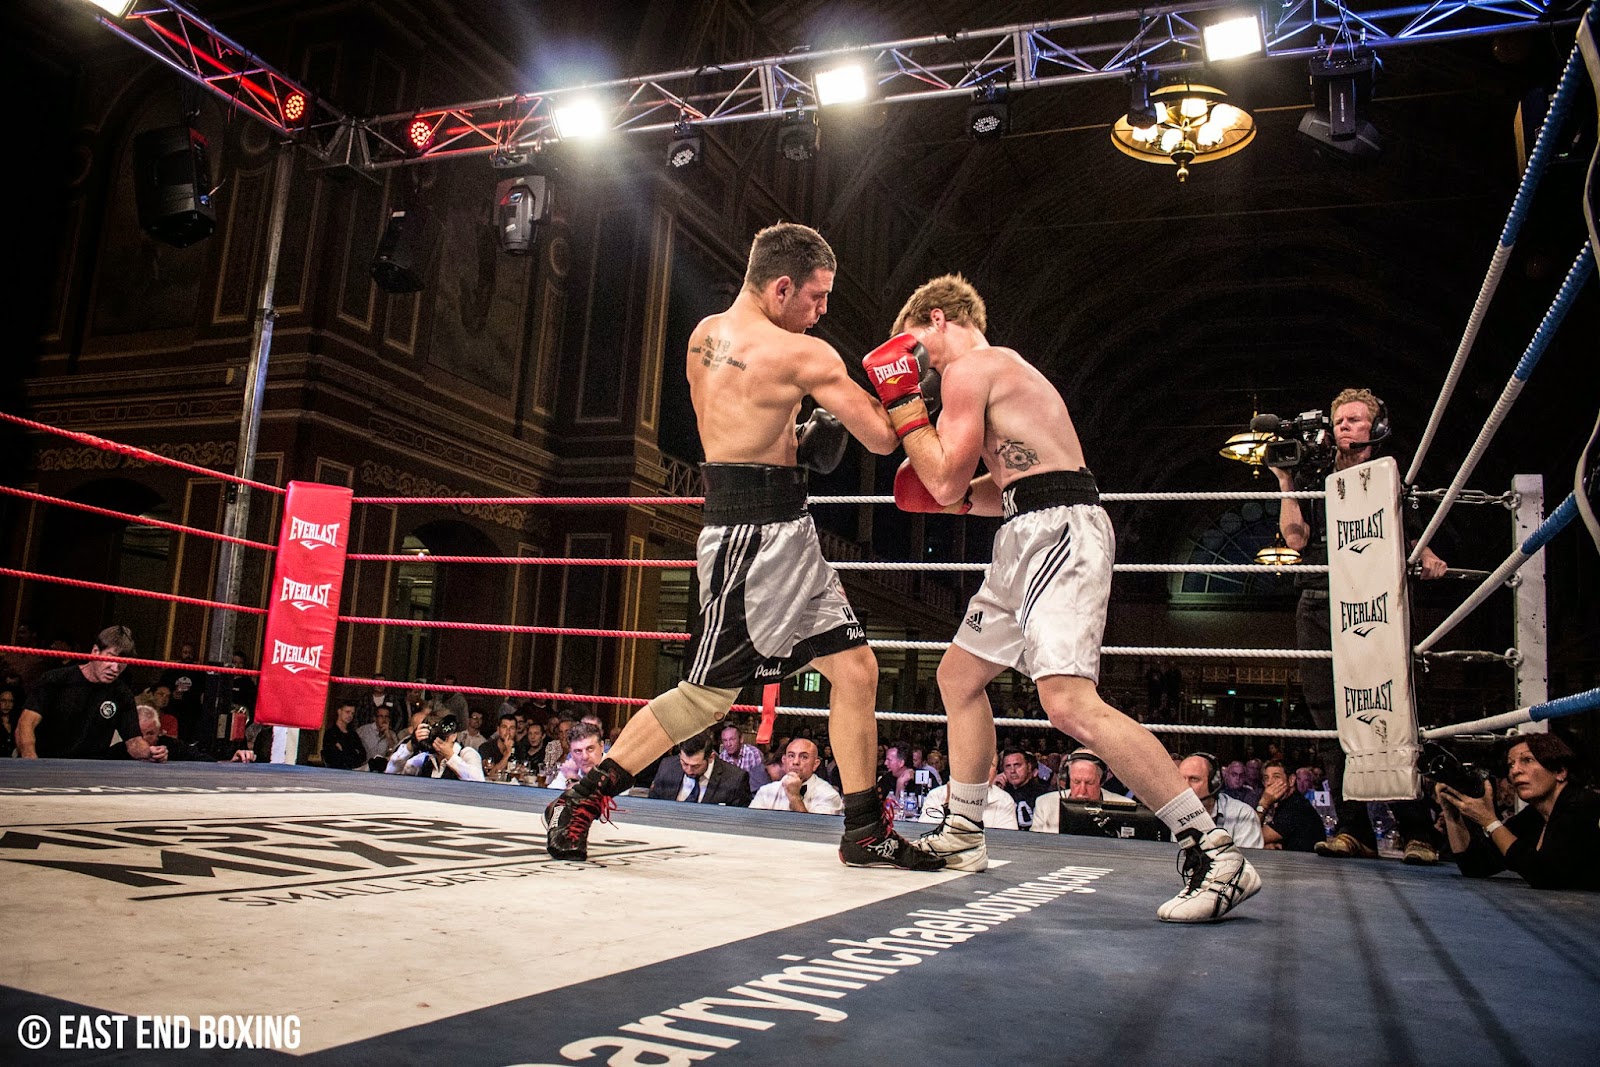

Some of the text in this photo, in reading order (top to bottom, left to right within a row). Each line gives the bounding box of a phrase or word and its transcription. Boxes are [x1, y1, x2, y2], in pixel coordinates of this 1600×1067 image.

[873, 355, 913, 385] EVERLAST
[289, 516, 340, 547] EVERLAST
[1336, 507, 1384, 551] EVERLAST
[280, 576, 331, 608] EVERLAST
[1340, 591, 1388, 633] EVERLAST
[272, 639, 323, 669] EVERLAST
[754, 661, 782, 679] Paul
[1343, 679, 1393, 719] EVERLAST
[950, 793, 984, 806] EVERLAST
[1178, 807, 1205, 826] EVERL
[217, 881, 427, 907] SMALL
[397, 864, 556, 888] BATCH
[503, 866, 1114, 1067] arrymichaelboxing.com
